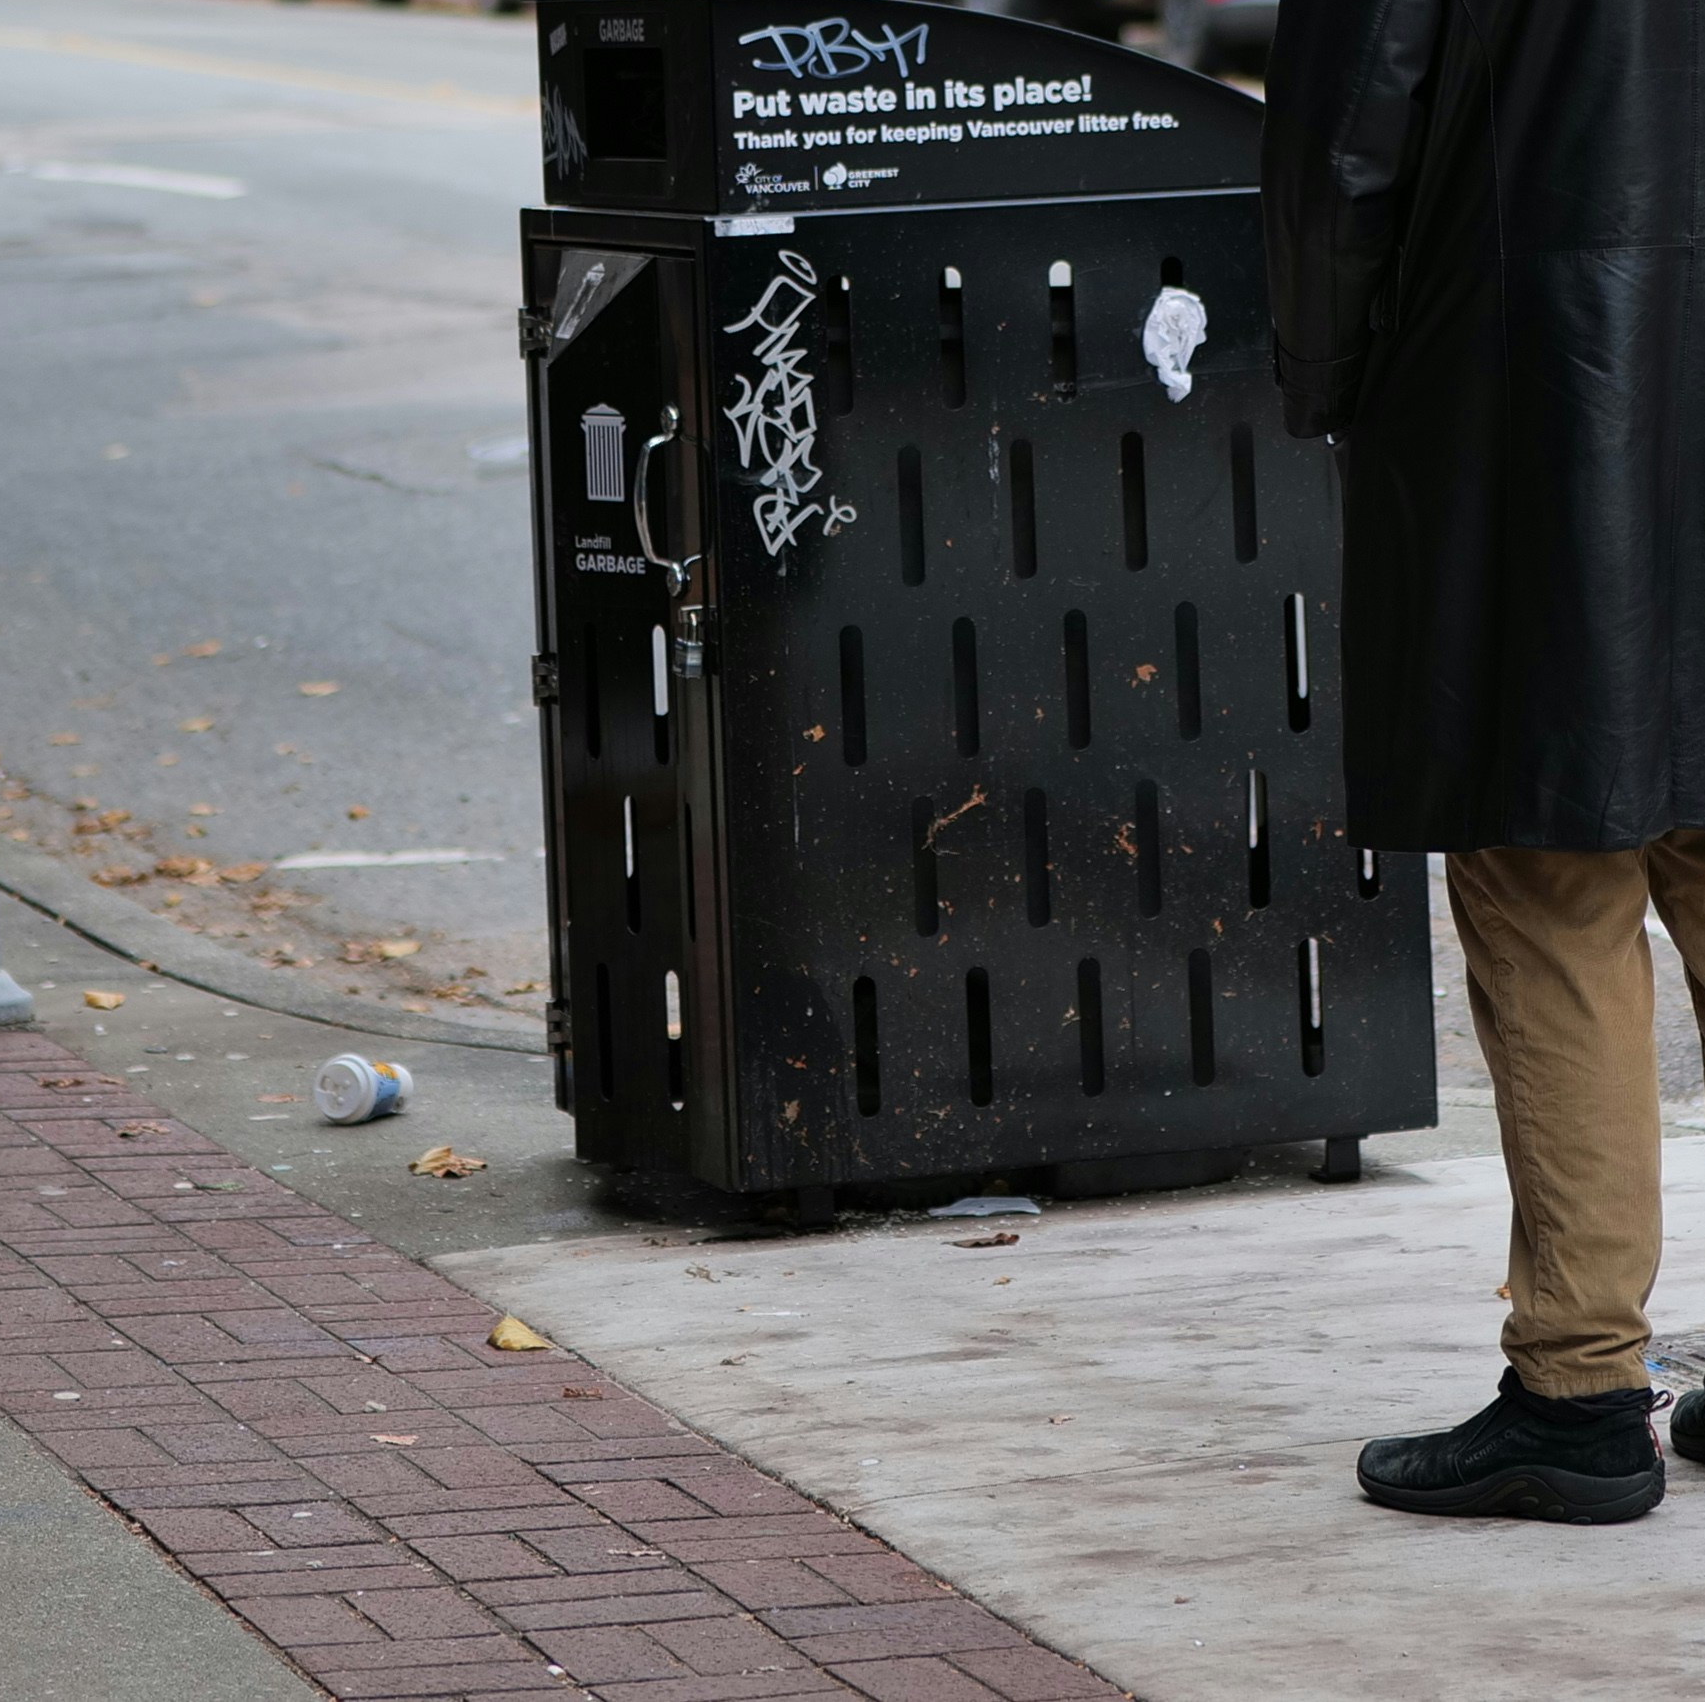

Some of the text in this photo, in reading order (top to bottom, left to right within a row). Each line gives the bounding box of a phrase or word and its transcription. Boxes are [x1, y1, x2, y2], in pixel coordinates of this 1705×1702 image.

[598, 18, 645, 42] GARBAGE
[733, 74, 1092, 118] Put waste in its place!
[734, 111, 1180, 150] Thank you for keeping Vancouver litter free.
[754, 174, 783, 184] CITY OF
[848, 168, 899, 180] GREENEST
[745, 181, 810, 195] VANCOUVER
[848, 179, 871, 188] CITY
[575, 534, 612, 550] Landfill
[576, 553, 646, 575] GARBAGE
